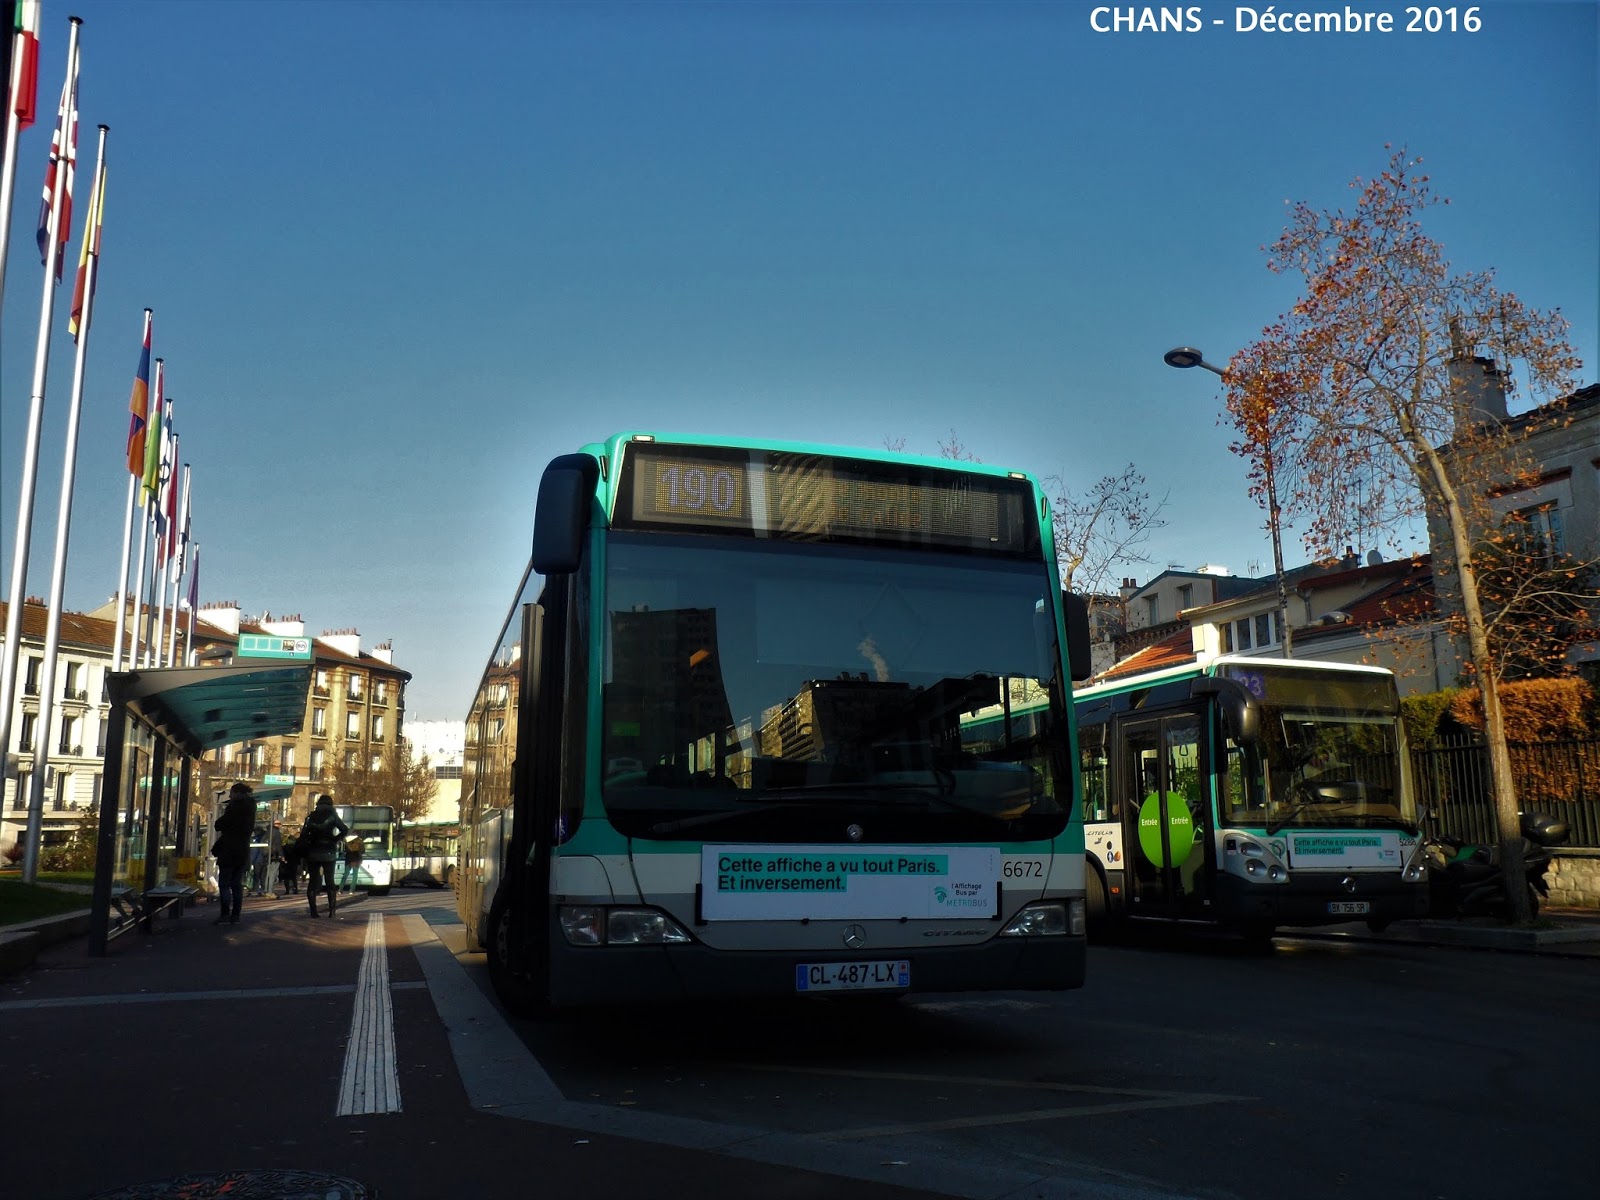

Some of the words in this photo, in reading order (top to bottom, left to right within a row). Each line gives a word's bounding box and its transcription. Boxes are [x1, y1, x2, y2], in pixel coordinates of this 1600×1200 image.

[661, 466, 736, 511] 190
[1141, 818, 1158, 826] Entrée
[1171, 817, 1189, 825] Entrée
[1294, 838, 1311, 846] Cette
[1312, 838, 1334, 846] affiche
[1349, 838, 1360, 846] tout
[718, 857, 763, 873] Cette
[767, 857, 822, 873] affiche
[826, 861, 836, 873] a
[840, 861, 859, 873] vu
[863, 858, 894, 873] tout
[897, 858, 940, 873] Paris.
[1003, 861, 1043, 877] 6672
[718, 875, 736, 890] Et
[740, 875, 846, 890] inversement.
[946, 899, 988, 907] METROBUS
[923, 928, 988, 937] CITARO
[899, 975, 908, 984] 75
